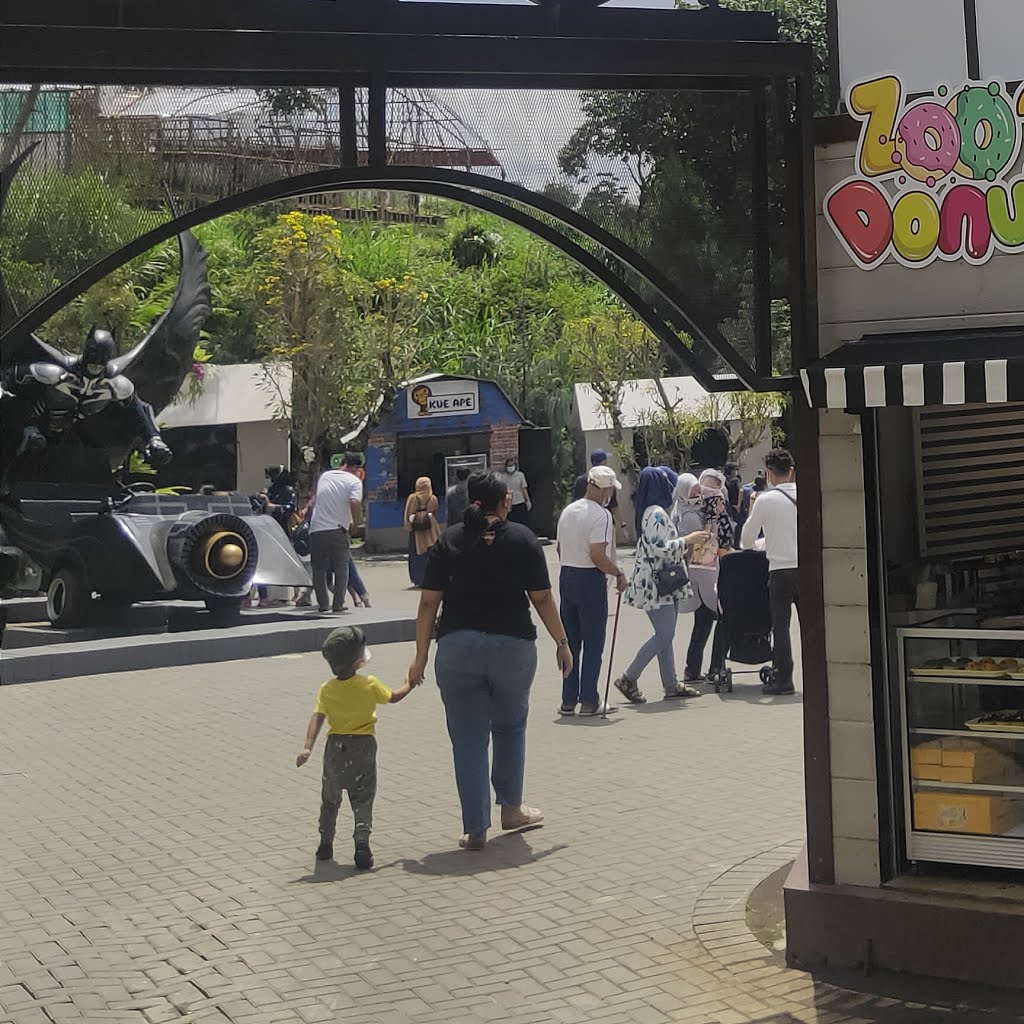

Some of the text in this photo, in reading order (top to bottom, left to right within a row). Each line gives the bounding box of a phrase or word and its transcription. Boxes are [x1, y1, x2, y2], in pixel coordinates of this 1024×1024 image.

[851, 76, 1017, 187] ZOO
[429, 397, 472, 409] KUE APE
